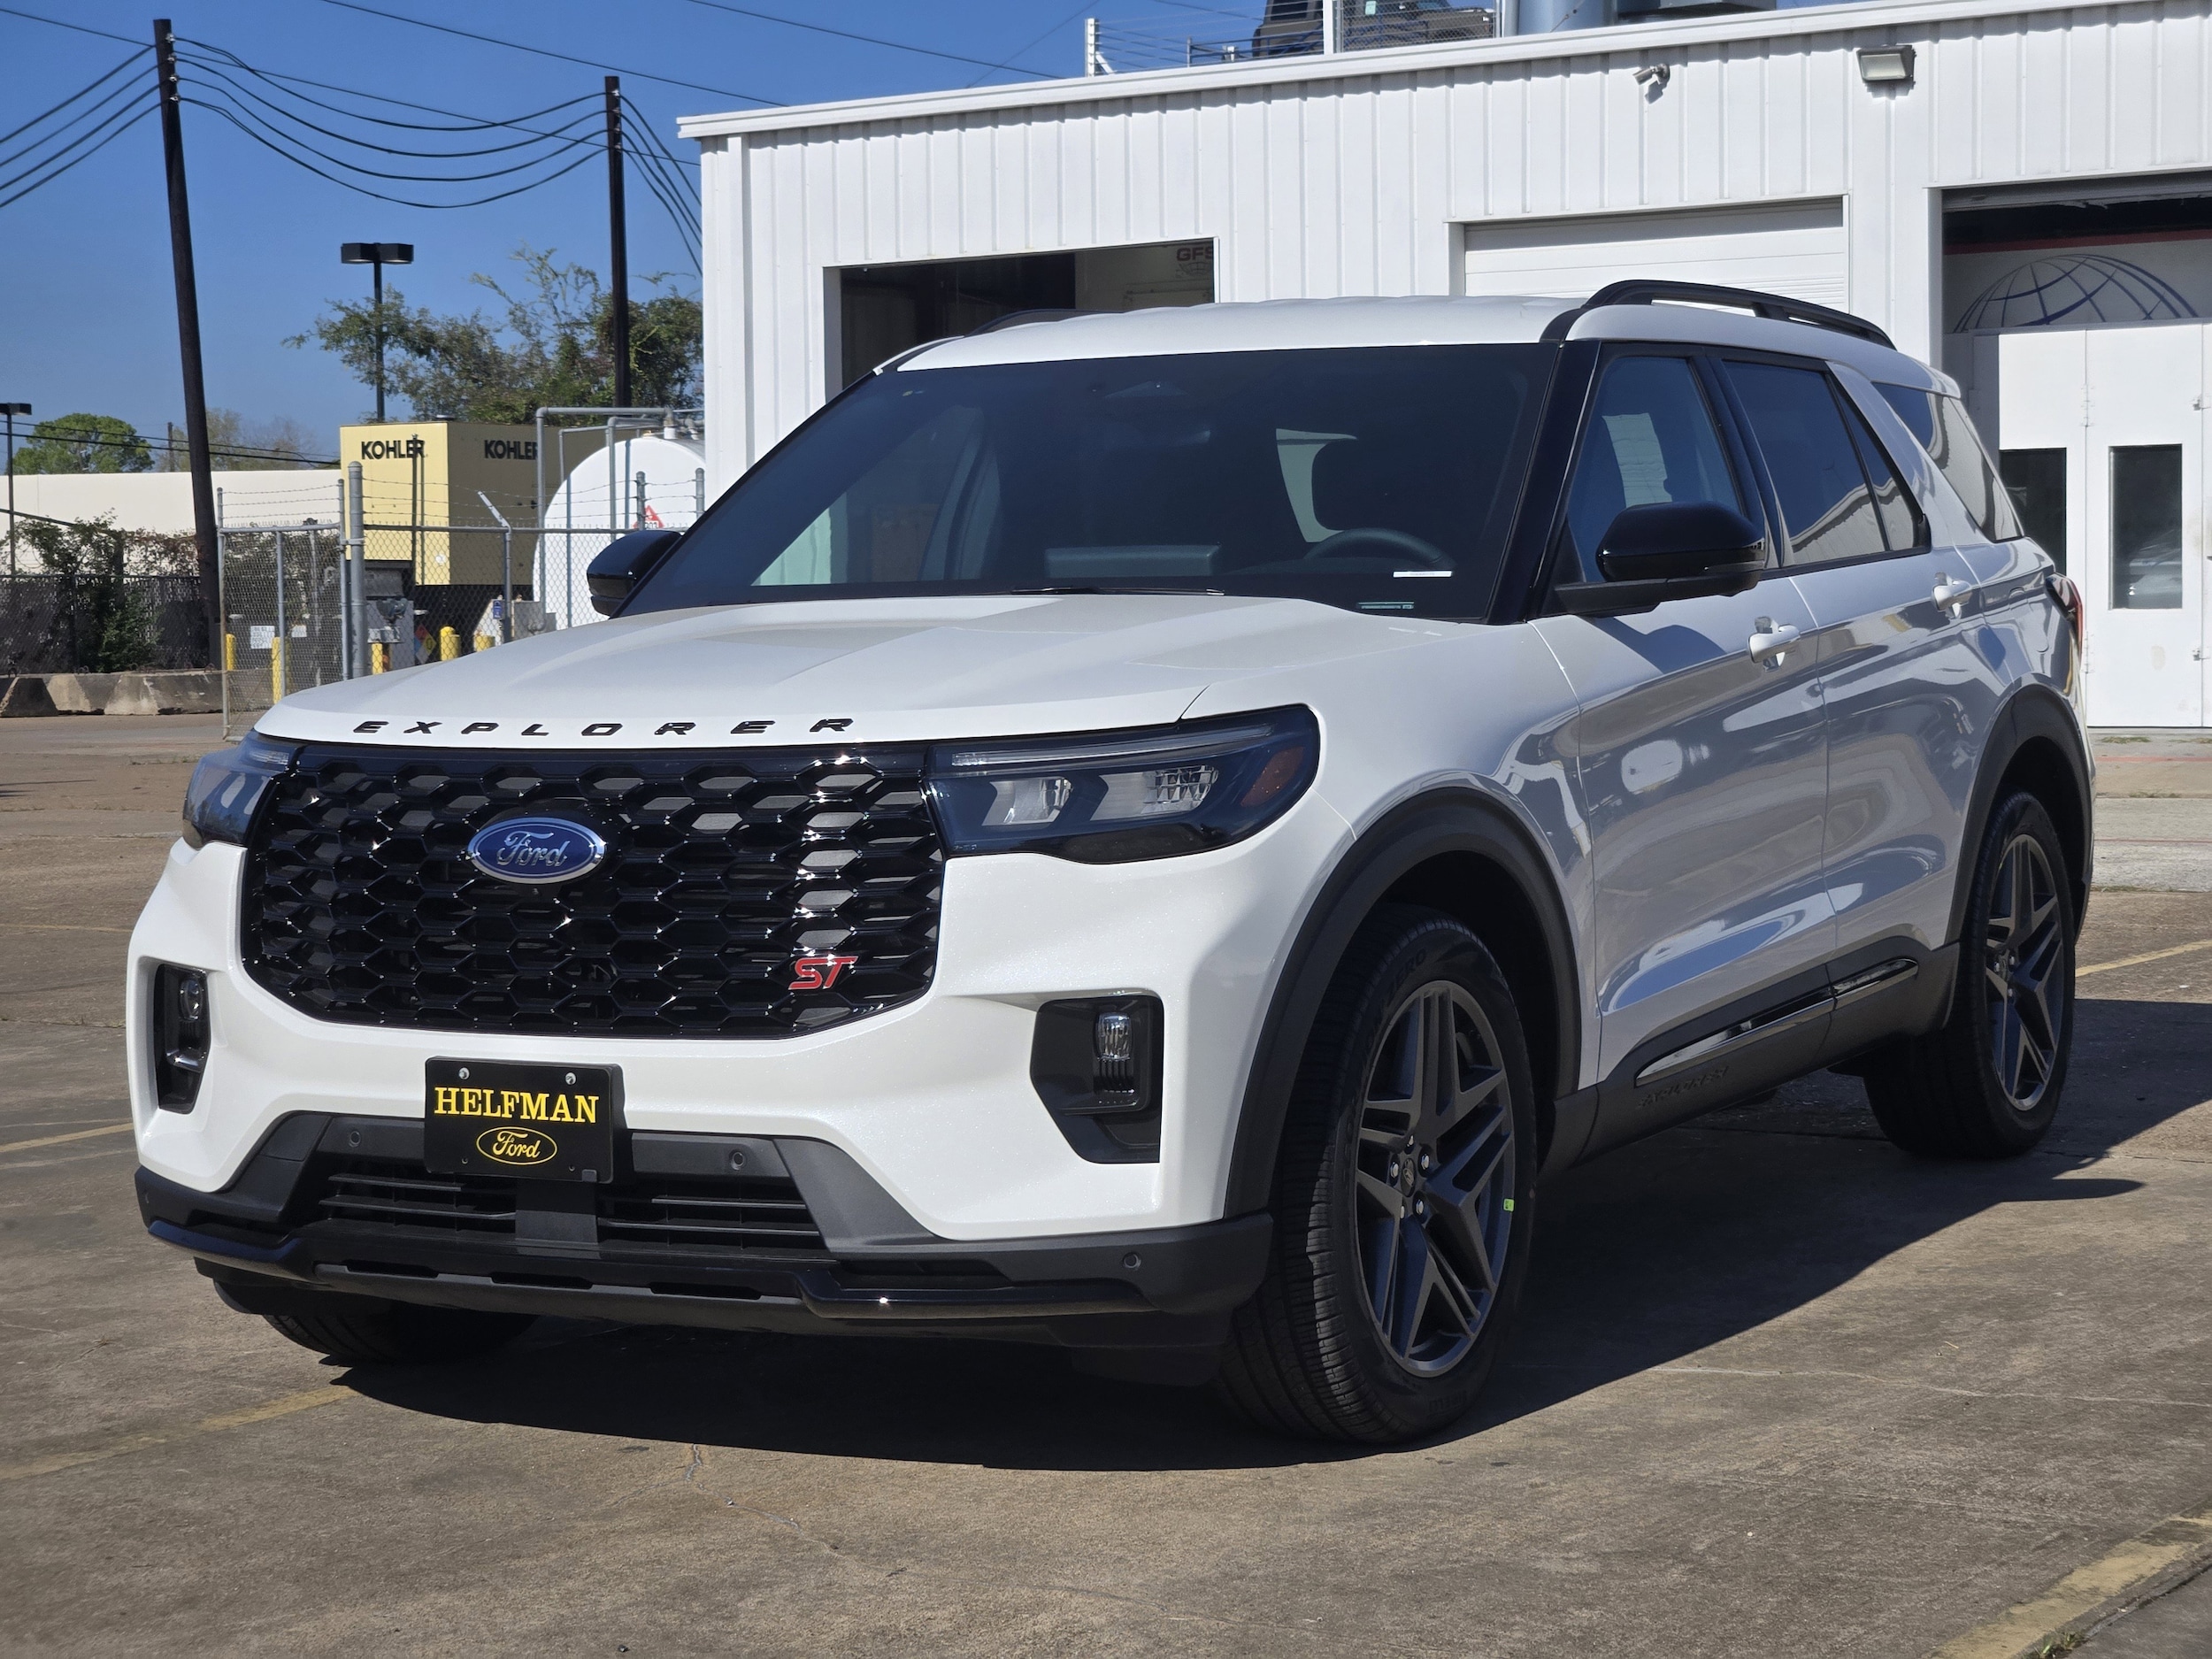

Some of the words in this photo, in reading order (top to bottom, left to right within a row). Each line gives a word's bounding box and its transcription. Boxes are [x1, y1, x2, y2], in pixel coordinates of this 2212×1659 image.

[361, 440, 426, 459] KOHLER
[353, 718, 854, 737] EXPLORER
[496, 830, 571, 867] Ford
[788, 956, 859, 990] ST
[434, 1087, 600, 1124] HELFMAN
[492, 1130, 541, 1158] Ford
